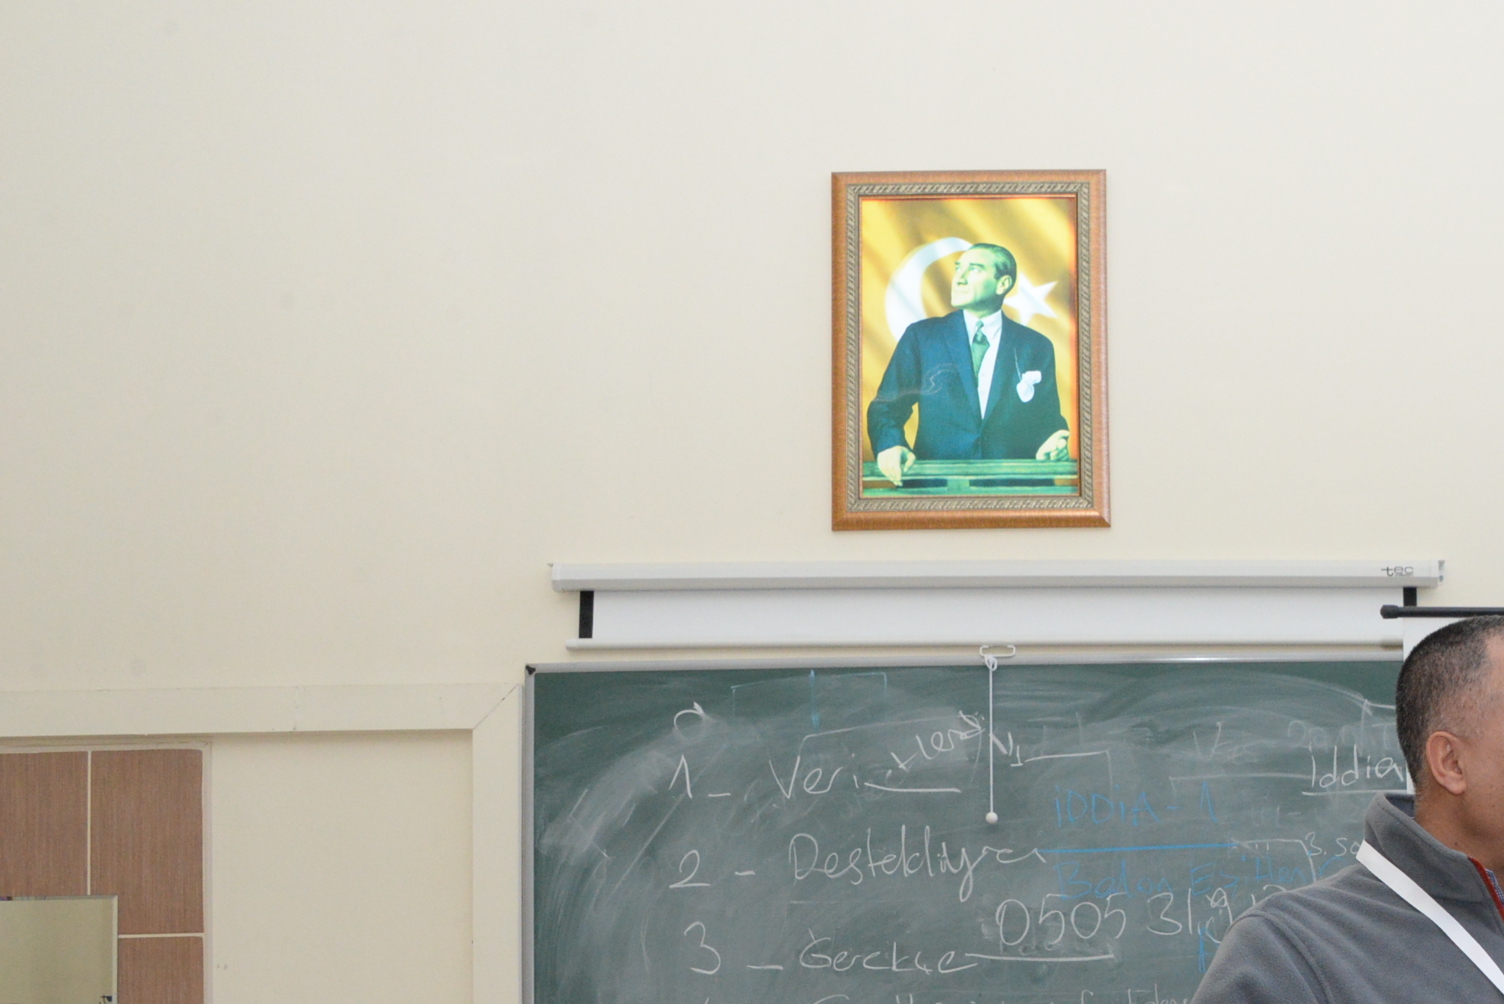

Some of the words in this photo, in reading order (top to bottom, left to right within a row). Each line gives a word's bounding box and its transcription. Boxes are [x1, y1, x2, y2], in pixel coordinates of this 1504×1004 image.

[669, 850, 711, 888] 2
[995, 892, 1126, 946] 0505
[684, 922, 721, 975] 3
